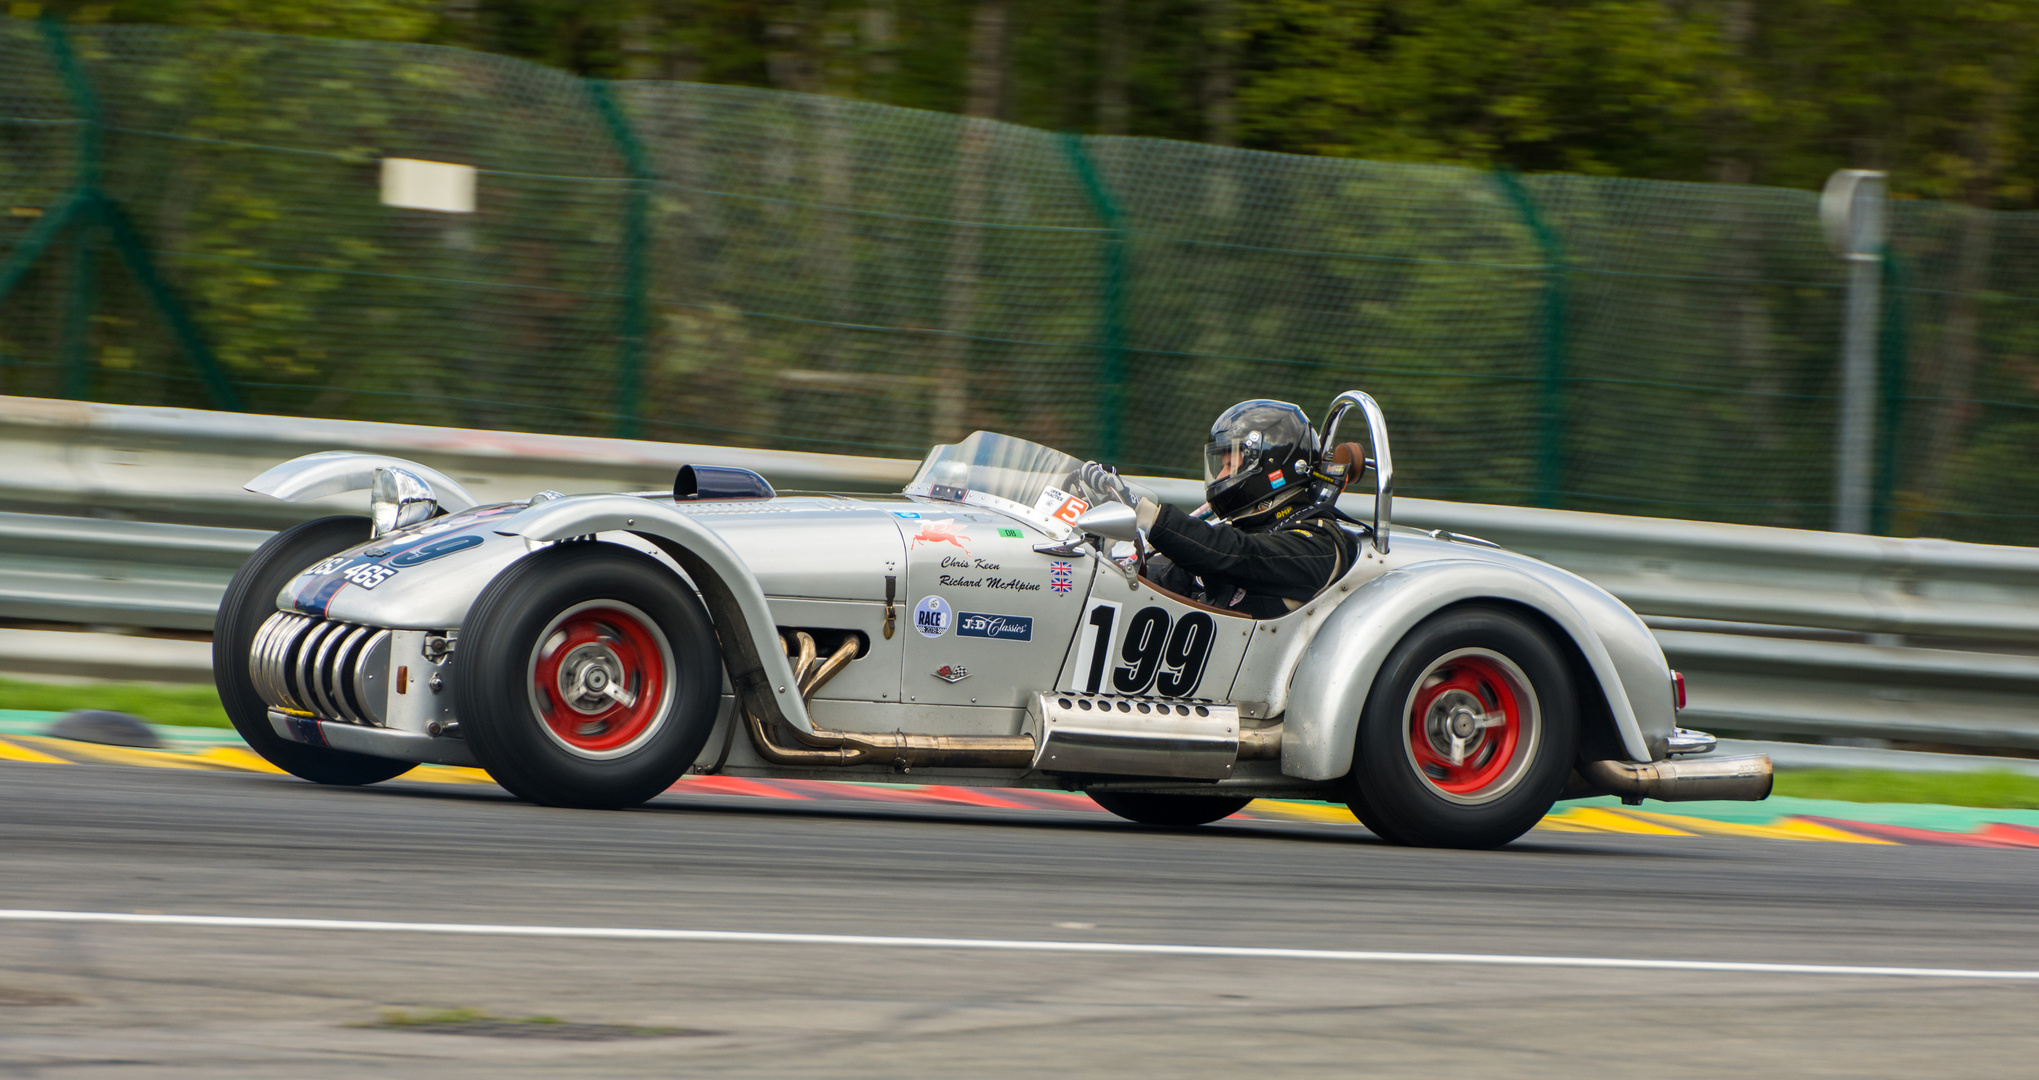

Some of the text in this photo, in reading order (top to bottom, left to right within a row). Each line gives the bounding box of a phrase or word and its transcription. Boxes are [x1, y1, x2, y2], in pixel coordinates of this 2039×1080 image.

[1061, 500, 1084, 523] 5
[1275, 506, 1292, 519] OMP
[941, 556, 1000, 570] Chris Keen
[343, 562, 395, 588] 465
[939, 574, 1040, 592] Richard McAlpine
[986, 615, 1027, 637] Classics
[1085, 604, 1218, 697] 199
